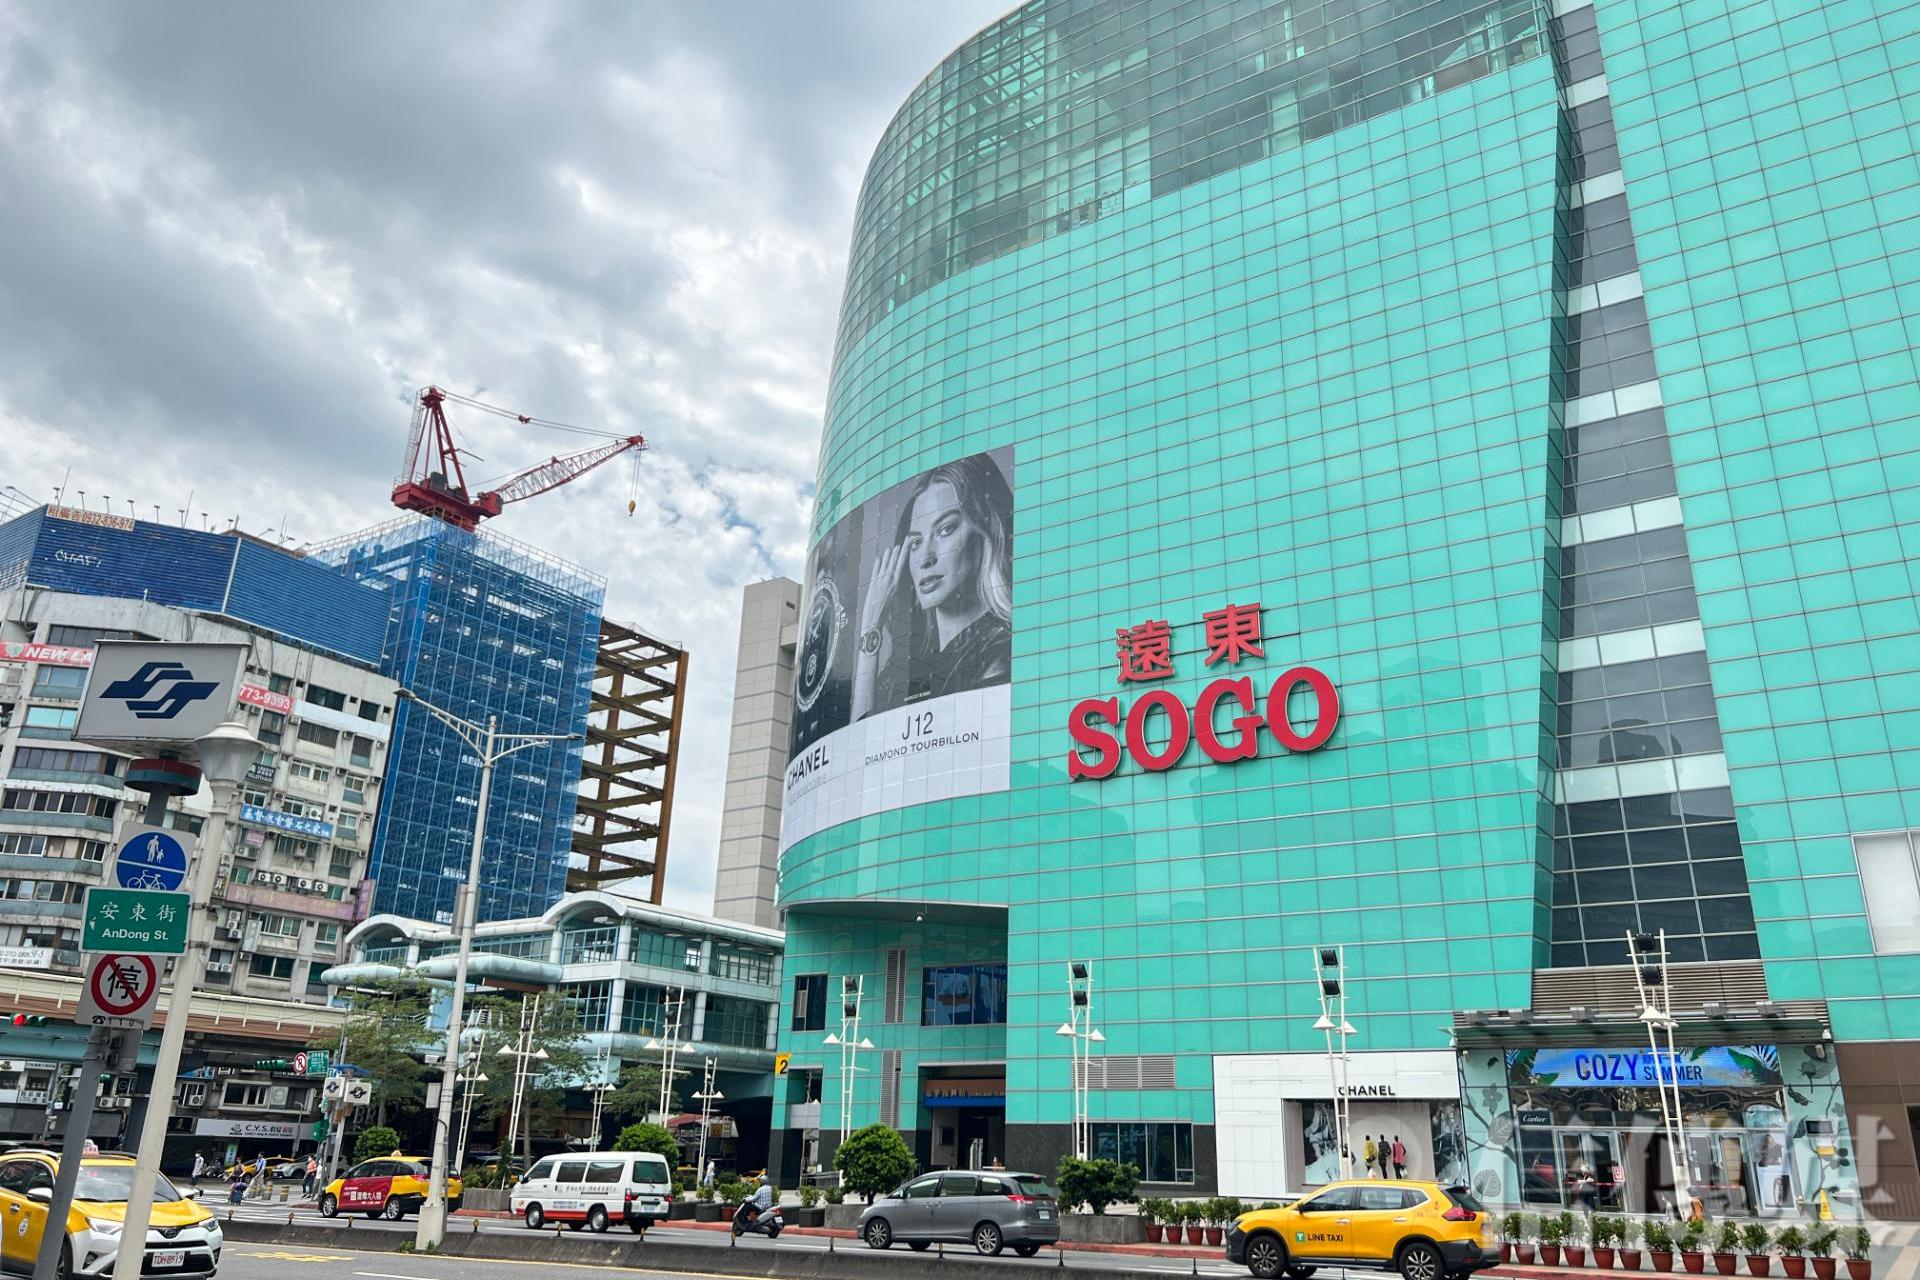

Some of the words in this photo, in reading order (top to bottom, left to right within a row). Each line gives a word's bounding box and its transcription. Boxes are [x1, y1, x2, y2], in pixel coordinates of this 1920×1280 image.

[25, 646, 67, 659] NEW
[1117, 602, 1264, 684] 遠東
[902, 712, 934, 740] J12
[1068, 667, 1340, 780] SOGO
[865, 746, 908, 766] DIAMOND
[911, 731, 980, 752] TOURBILLON
[787, 745, 830, 790] CHANEL
[100, 901, 177, 923] 安東街
[101, 928, 150, 942] AnDong
[154, 930, 169, 941] St.
[107, 963, 142, 1000] 停
[780, 1059, 789, 1075] 2
[1575, 1053, 1640, 1081] COZY
[1643, 1065, 1703, 1081] SUMMER
[1338, 1084, 1396, 1097] CHANEL
[1522, 1114, 1548, 1122] Cartier
[1307, 1233, 1325, 1241] LINE
[1327, 1234, 1344, 1242] TAXI
